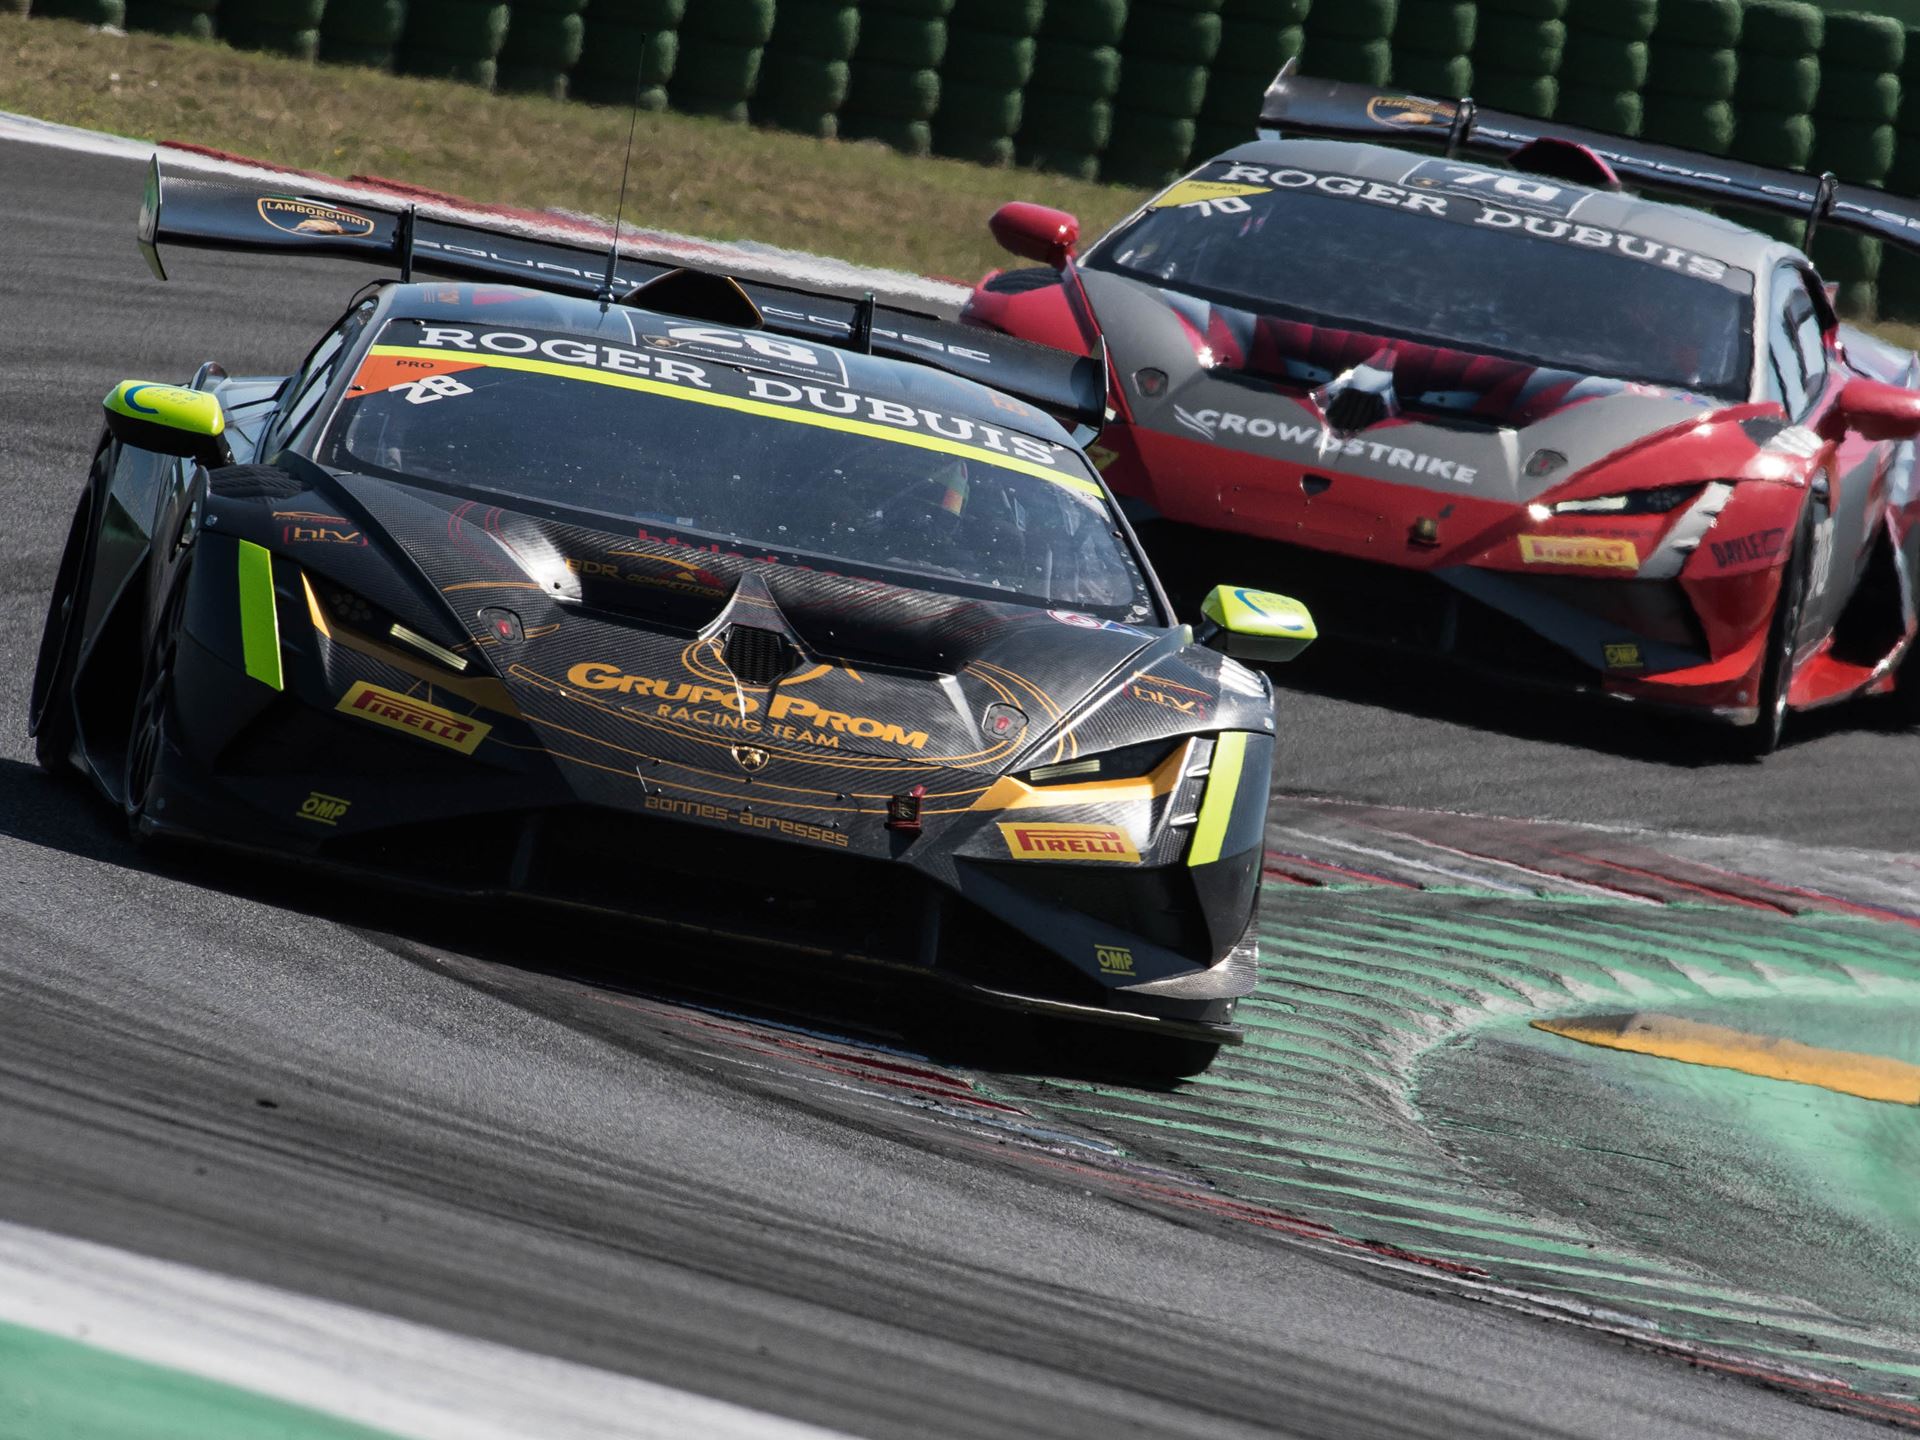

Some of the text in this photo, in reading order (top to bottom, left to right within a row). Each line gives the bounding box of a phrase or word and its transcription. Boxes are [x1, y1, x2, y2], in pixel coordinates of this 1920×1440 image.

[266, 201, 367, 226] LAMBORGHINI
[1178, 196, 1252, 217] 70
[1219, 165, 1448, 216] ROGER
[1474, 207, 1726, 281] DUBUIS
[396, 360, 434, 369] PRO
[388, 374, 474, 405] 28
[418, 327, 712, 388] ROGER
[747, 375, 1056, 465] DUBUIS
[1194, 408, 1479, 485] CROWDSTRIKE
[352, 689, 475, 743] PIRELLI
[567, 662, 929, 750] GRUPO PROM
[656, 703, 840, 749] RACING TEAM
[302, 797, 347, 820] OMP
[1014, 829, 1126, 854] PIRELLI
[1096, 949, 1134, 971] OMP
